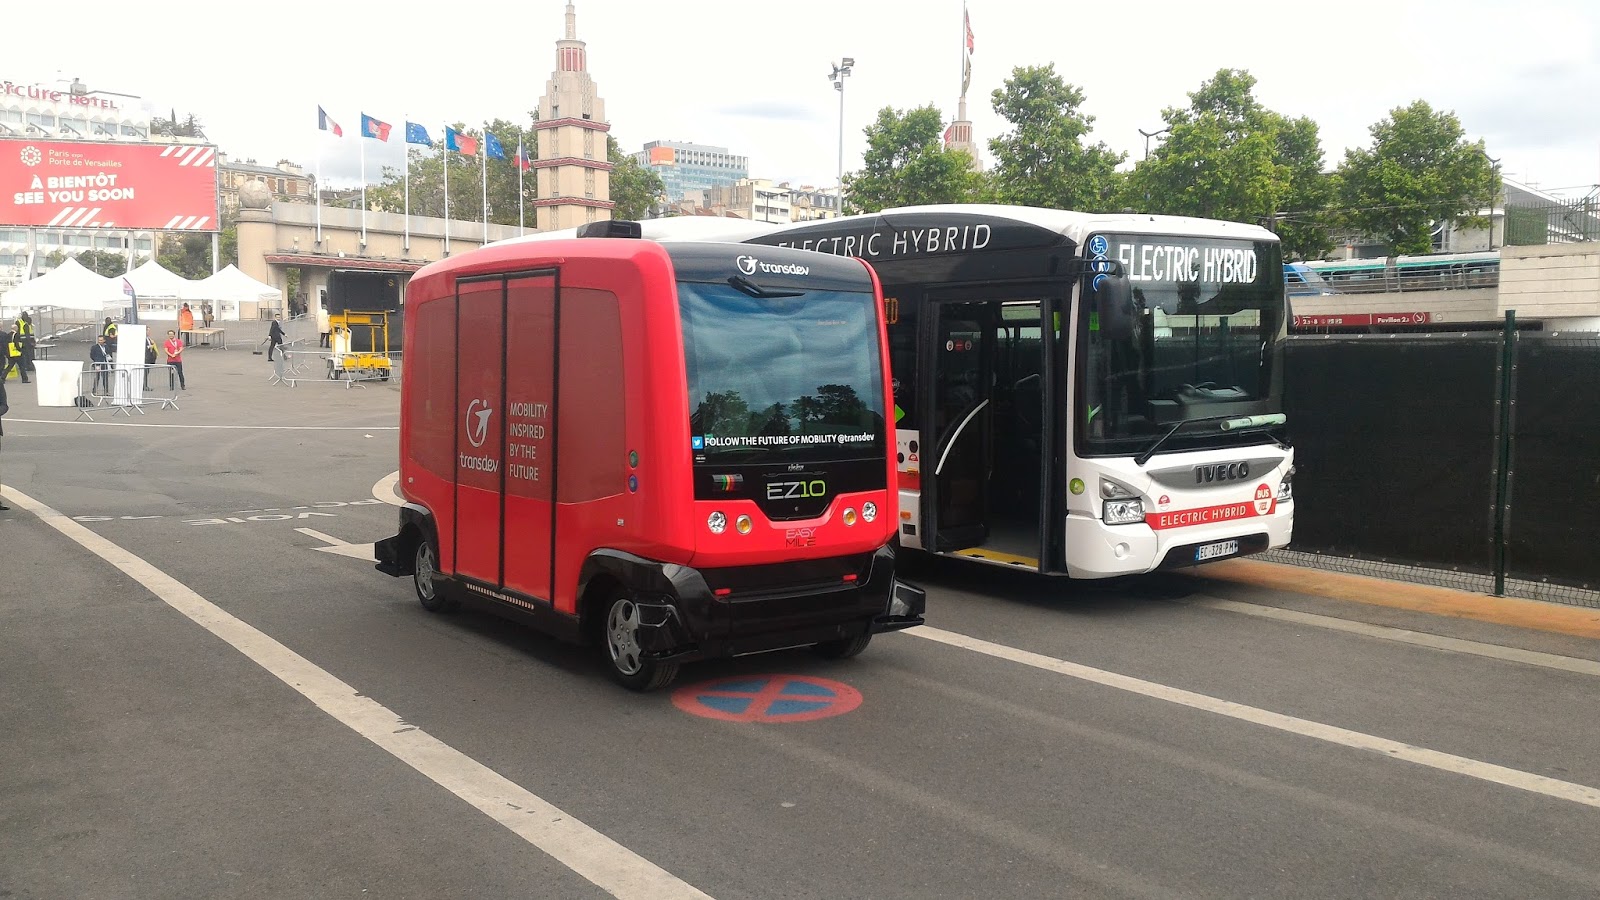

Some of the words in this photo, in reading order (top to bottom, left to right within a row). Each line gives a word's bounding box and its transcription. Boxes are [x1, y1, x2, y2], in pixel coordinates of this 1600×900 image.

[69, 95, 118, 109] HOTEL
[49, 149, 70, 157] Paris
[84, 159, 122, 167] Versailles
[31, 174, 43, 190] À
[47, 171, 117, 189] BIENTÔT
[14, 191, 45, 205] SEE
[48, 190, 84, 203] YOU
[88, 187, 134, 201] SOON
[779, 233, 881, 257] ECTRIC
[892, 224, 992, 255] HYBRID
[759, 261, 810, 277] transdev
[1118, 243, 1200, 282] ELECTRIC
[1203, 247, 1257, 284] HYBRID
[1377, 316, 1400, 324] Pavillon
[509, 402, 548, 419] MOBILITY
[509, 423, 545, 440] INSPIRED
[705, 436, 740, 447] FOLLOW
[740, 436, 758, 446] THE
[758, 435, 789, 445] FUTURE
[789, 435, 800, 444] OF
[800, 434, 837, 444] MOBILITY
[837, 432, 874, 444] @transdev
[509, 443, 521, 457] BY
[521, 444, 536, 459] THE
[459, 451, 499, 473] transdev
[509, 463, 539, 481] FUTURE
[1195, 461, 1249, 484] IVECO
[766, 480, 826, 500] EZ10
[1257, 489, 1270, 498] BUS
[1160, 512, 1208, 527] ELECTRIC
[1212, 505, 1246, 519] HYBRID
[786, 527, 817, 539] EASY
